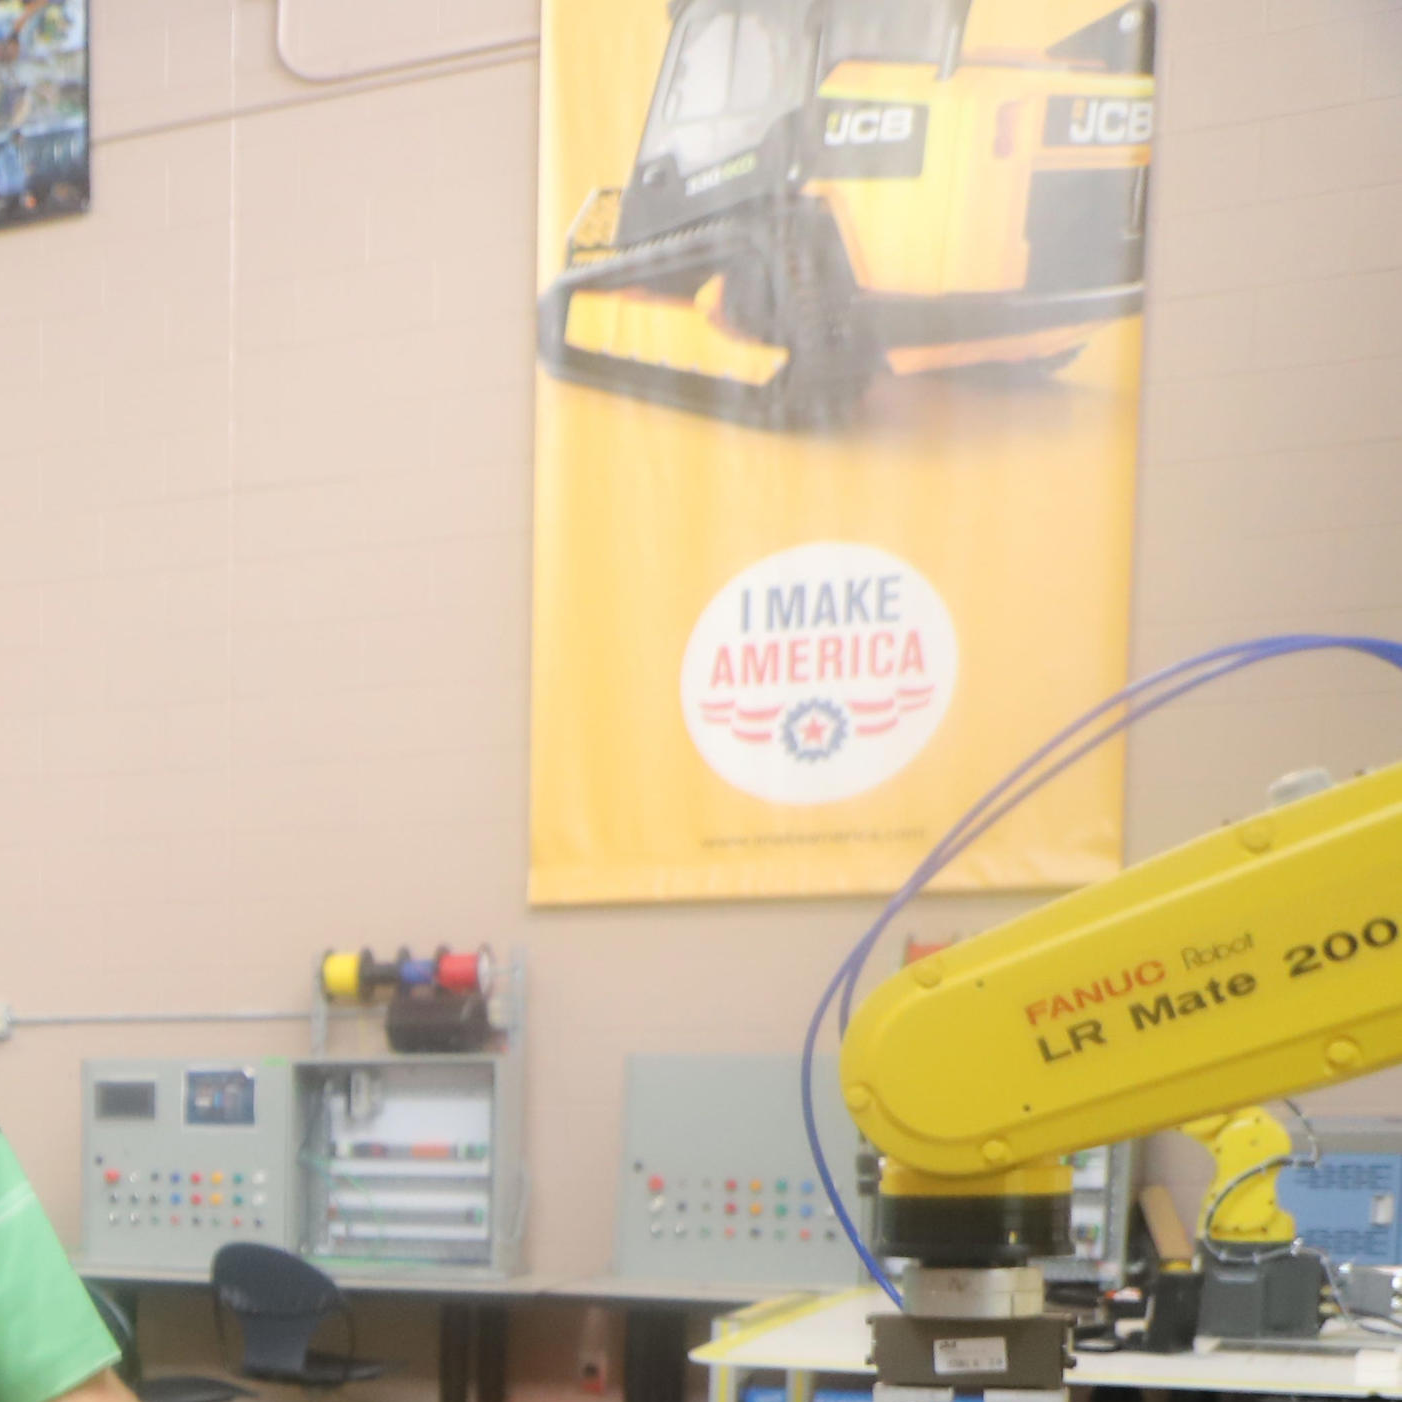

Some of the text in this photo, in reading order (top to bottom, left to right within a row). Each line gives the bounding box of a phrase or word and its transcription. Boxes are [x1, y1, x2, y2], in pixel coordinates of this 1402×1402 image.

[825, 106, 913, 146] JCB
[1069, 99, 1153, 145] JCB
[740, 575, 901, 633] I MAKE
[709, 627, 926, 688] AMERICA
[1025, 932, 1255, 1026] FANUC Robot
[1037, 917, 1399, 1063] LR Mate 200
